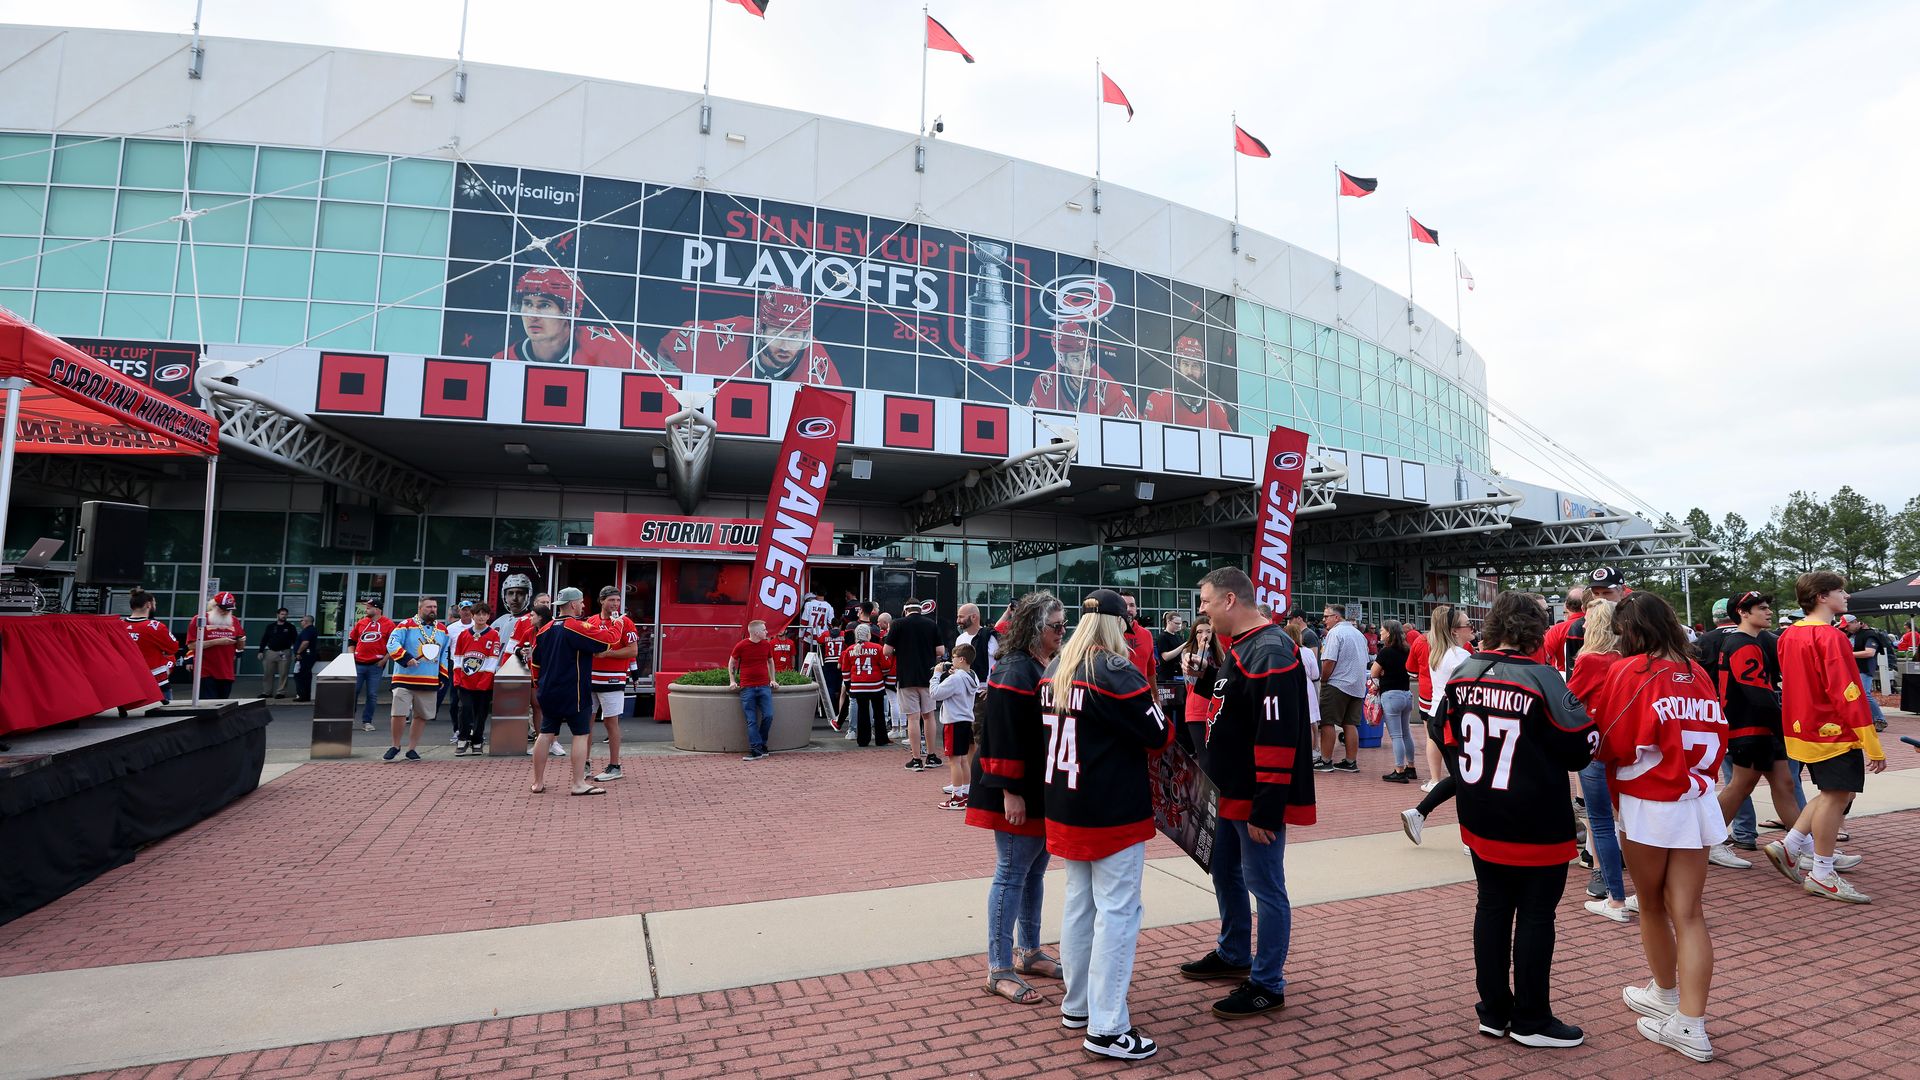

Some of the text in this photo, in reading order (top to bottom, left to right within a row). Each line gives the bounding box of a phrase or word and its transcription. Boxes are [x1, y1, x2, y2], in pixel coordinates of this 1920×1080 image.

[492, 180, 576, 205] invisalign
[726, 210, 939, 266] STANLEY CUP
[681, 238, 939, 312] PLAYOFFS
[893, 321, 940, 344] 2023
[77, 344, 149, 359] NLEY CUP
[49, 357, 212, 446] CAROLINA HURRICANES
[640, 520, 714, 544] STORM
[758, 450, 828, 618] CANES
[1255, 479, 1298, 615] CANES
[494, 562, 509, 573] 86
[810, 612, 826, 629] 74
[485, 640, 493, 650] C
[626, 631, 638, 644] 20
[827, 640, 843, 656] 37
[848, 648, 878, 658] WLIAMS
[855, 657, 873, 675] 14
[1041, 685, 1085, 711] SLIN
[1263, 695, 1280, 721] 11
[1042, 713, 1080, 789] 74
[1458, 711, 1521, 791] 37
